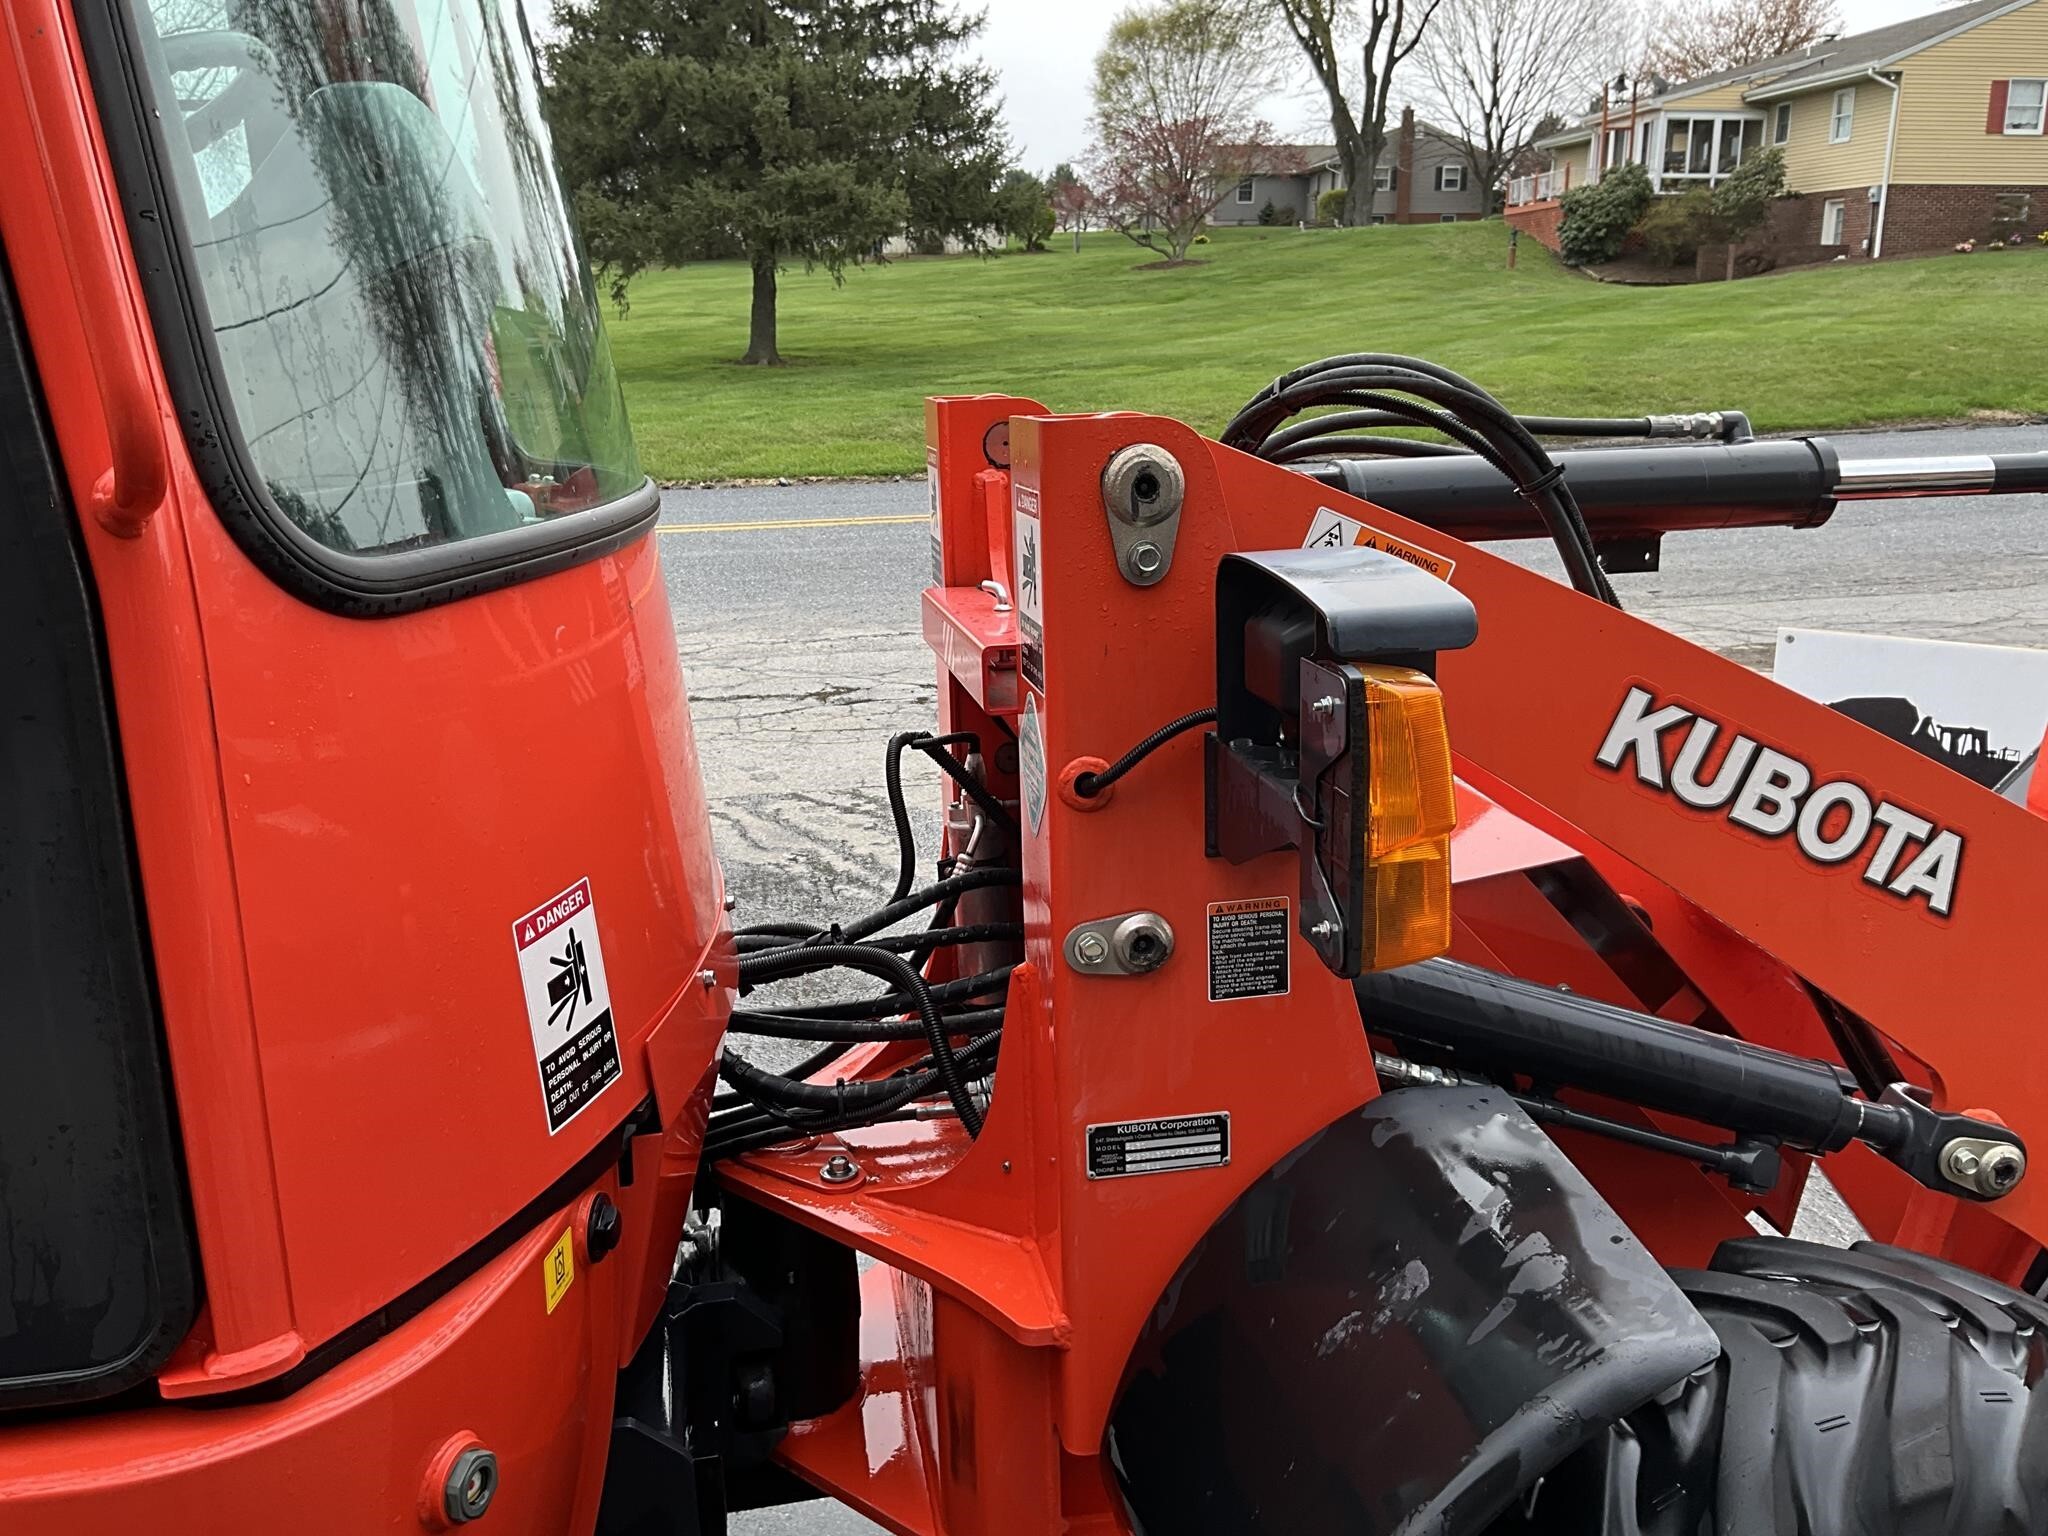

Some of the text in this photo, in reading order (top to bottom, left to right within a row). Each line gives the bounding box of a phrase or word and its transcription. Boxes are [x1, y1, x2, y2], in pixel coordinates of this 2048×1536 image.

[1386, 543, 1439, 573] WARNING
[1595, 686, 1964, 916] KUBOTA
[536, 890, 585, 932] DANGER
[1226, 900, 1280, 912] WARNING
[546, 1025, 601, 1074] TO AVOID SERIOUS
[548, 1059, 581, 1088] PERSONAL
[582, 1039, 601, 1061] INJURY
[604, 1031, 611, 1042] OR
[553, 1099, 567, 1116] KEEP
[569, 1088, 580, 1102] OUT
[582, 1080, 589, 1092] OF
[591, 1069, 602, 1083] THIS
[604, 1058, 615, 1073] AREA
[1117, 1123, 1158, 1134] KUBOTA
[1160, 1117, 1215, 1131] Corporation
